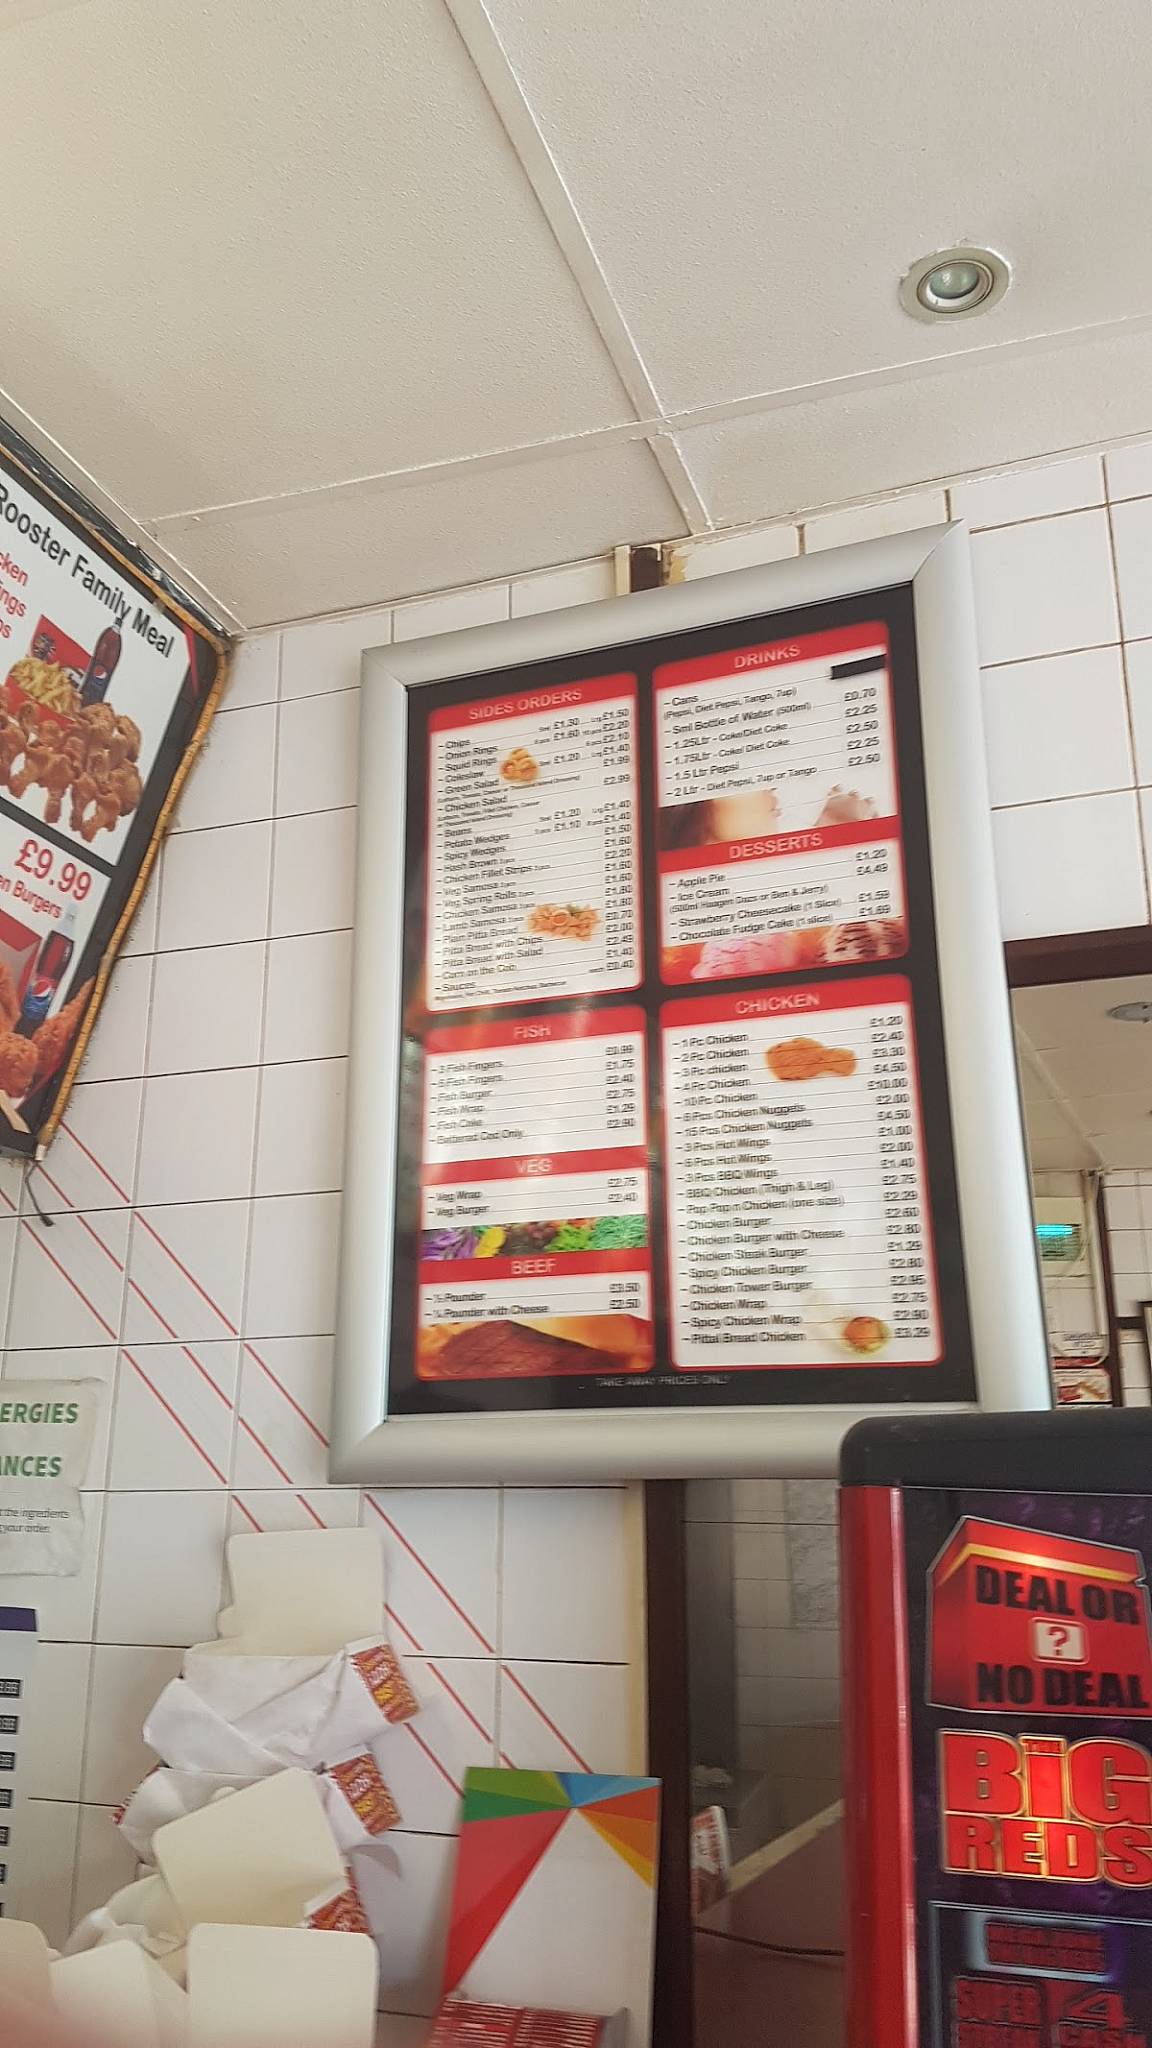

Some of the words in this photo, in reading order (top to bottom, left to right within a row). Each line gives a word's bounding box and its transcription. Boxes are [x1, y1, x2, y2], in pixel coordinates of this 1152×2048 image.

[72, 554, 131, 620] Family
[132, 608, 174, 658] Meal
[734, 644, 800, 669] DRINKS
[470, 701, 513, 721] SIDES
[517, 688, 582, 712] ORDERS
[672, 694, 698, 707] Cans
[695, 717, 725, 731] Bottle
[742, 708, 773, 722] Water
[764, 722, 787, 734] Coke
[845, 704, 877, 718] £2.25
[446, 738, 470, 750] Chips
[474, 744, 497, 756] Rings
[603, 720, 629, 732] £2.20
[746, 742, 765, 753] Diet
[767, 738, 790, 749] Coke
[847, 720, 878, 734] £2.50
[446, 761, 471, 773] Squid
[473, 756, 497, 768] Rings
[710, 762, 739, 776] Pepsi
[848, 737, 879, 750] £2.25
[445, 770, 483, 783] Coleslaw
[707, 780, 726, 791] Diet
[787, 765, 817, 780] Tango
[849, 753, 881, 767] £2.50
[445, 783, 473, 794] Green
[476, 778, 498, 789] Salad
[445, 800, 480, 813] Chicken
[483, 795, 506, 806] Salad
[445, 838, 472, 849] Potato
[474, 831, 510, 846] Wedges
[730, 833, 822, 859] DESSERTS
[444, 850, 468, 862] Spicy
[471, 844, 506, 858] Wedges
[15, 839, 92, 901] £9.99
[470, 857, 496, 868] Brown
[444, 872, 478, 884] Chicken
[481, 868, 503, 878] Fillet
[505, 864, 532, 876] Strips
[678, 876, 706, 889] Apple
[709, 873, 725, 883] Pie
[463, 881, 497, 893] Samosa
[678, 891, 693, 901] Ice
[696, 886, 729, 899] Cream
[13, 880, 62, 918] Burgers
[494, 890, 516, 901] Rolls
[443, 907, 478, 920] Chicken
[481, 902, 517, 914] Samosa
[679, 912, 735, 929] Strawberry
[737, 902, 800, 919] Cheesecake
[470, 916, 505, 928] Samosa
[679, 927, 730, 942] Chocolate
[733, 922, 765, 936] Fudge
[767, 918, 794, 930] Cake
[490, 926, 517, 937] Bread
[517, 934, 543, 947] Chips
[517, 947, 543, 958] Salad
[442, 980, 476, 992] Sauces
[736, 992, 820, 1015] CHICKEN
[513, 1023, 551, 1040] FISH
[706, 1032, 748, 1045] Chicken
[706, 1047, 749, 1060] Chicken
[467, 1059, 504, 1072] Fingers
[707, 1077, 750, 1089] Chicken
[714, 1092, 758, 1104] Chicken
[714, 1107, 759, 1119] Chicken
[760, 1103, 806, 1117] Nuggets
[721, 1122, 766, 1134] Chicken
[768, 1118, 813, 1132] Nuggets
[737, 1137, 771, 1150] Wings
[516, 1158, 552, 1174] VEG
[738, 1152, 772, 1166] Wings
[745, 1167, 778, 1181] Wings
[714, 1185, 756, 1197] Chicken
[456, 1204, 489, 1216] Burger
[742, 1199, 787, 1211] Chicken
[687, 1218, 729, 1230] Chicken
[733, 1216, 772, 1229] Burger
[688, 1234, 730, 1246] Chicken
[733, 1232, 773, 1245] Burger
[775, 1230, 798, 1241] with
[801, 1227, 845, 1240] Cheese
[688, 1250, 731, 1262] Chicken
[734, 1248, 766, 1259] Steak
[768, 1246, 809, 1260] Burger
[511, 1259, 556, 1275] BEEF
[689, 1268, 718, 1280] Spicy
[721, 1265, 765, 1277] Chicken
[768, 1263, 808, 1276] Burger
[690, 1283, 734, 1295] Chicken
[737, 1282, 771, 1292] Tower
[772, 1279, 813, 1293] Burger
[445, 1291, 486, 1302] Pounder
[690, 1300, 735, 1311] Chicken
[737, 1298, 766, 1311] Wrap
[445, 1307, 484, 1317] Pounder
[488, 1306, 508, 1315] with
[510, 1304, 549, 1314] Cheese
[690, 1317, 720, 1330] Spicy
[723, 1315, 768, 1326] Chicken
[771, 1314, 801, 1326] Wrap
[722, 1332, 757, 1343] Bread
[759, 1330, 807, 1342] Chicken
[0, 1403, 79, 1424] ERGIES
[0, 1455, 61, 1477] NCES
[976, 1564, 1075, 1616] DEAL
[1081, 1583, 1140, 1625] OR
[977, 1662, 1033, 1705] NO
[1043, 1668, 1148, 1708] DEAL
[942, 1813, 1152, 1888] REDS
